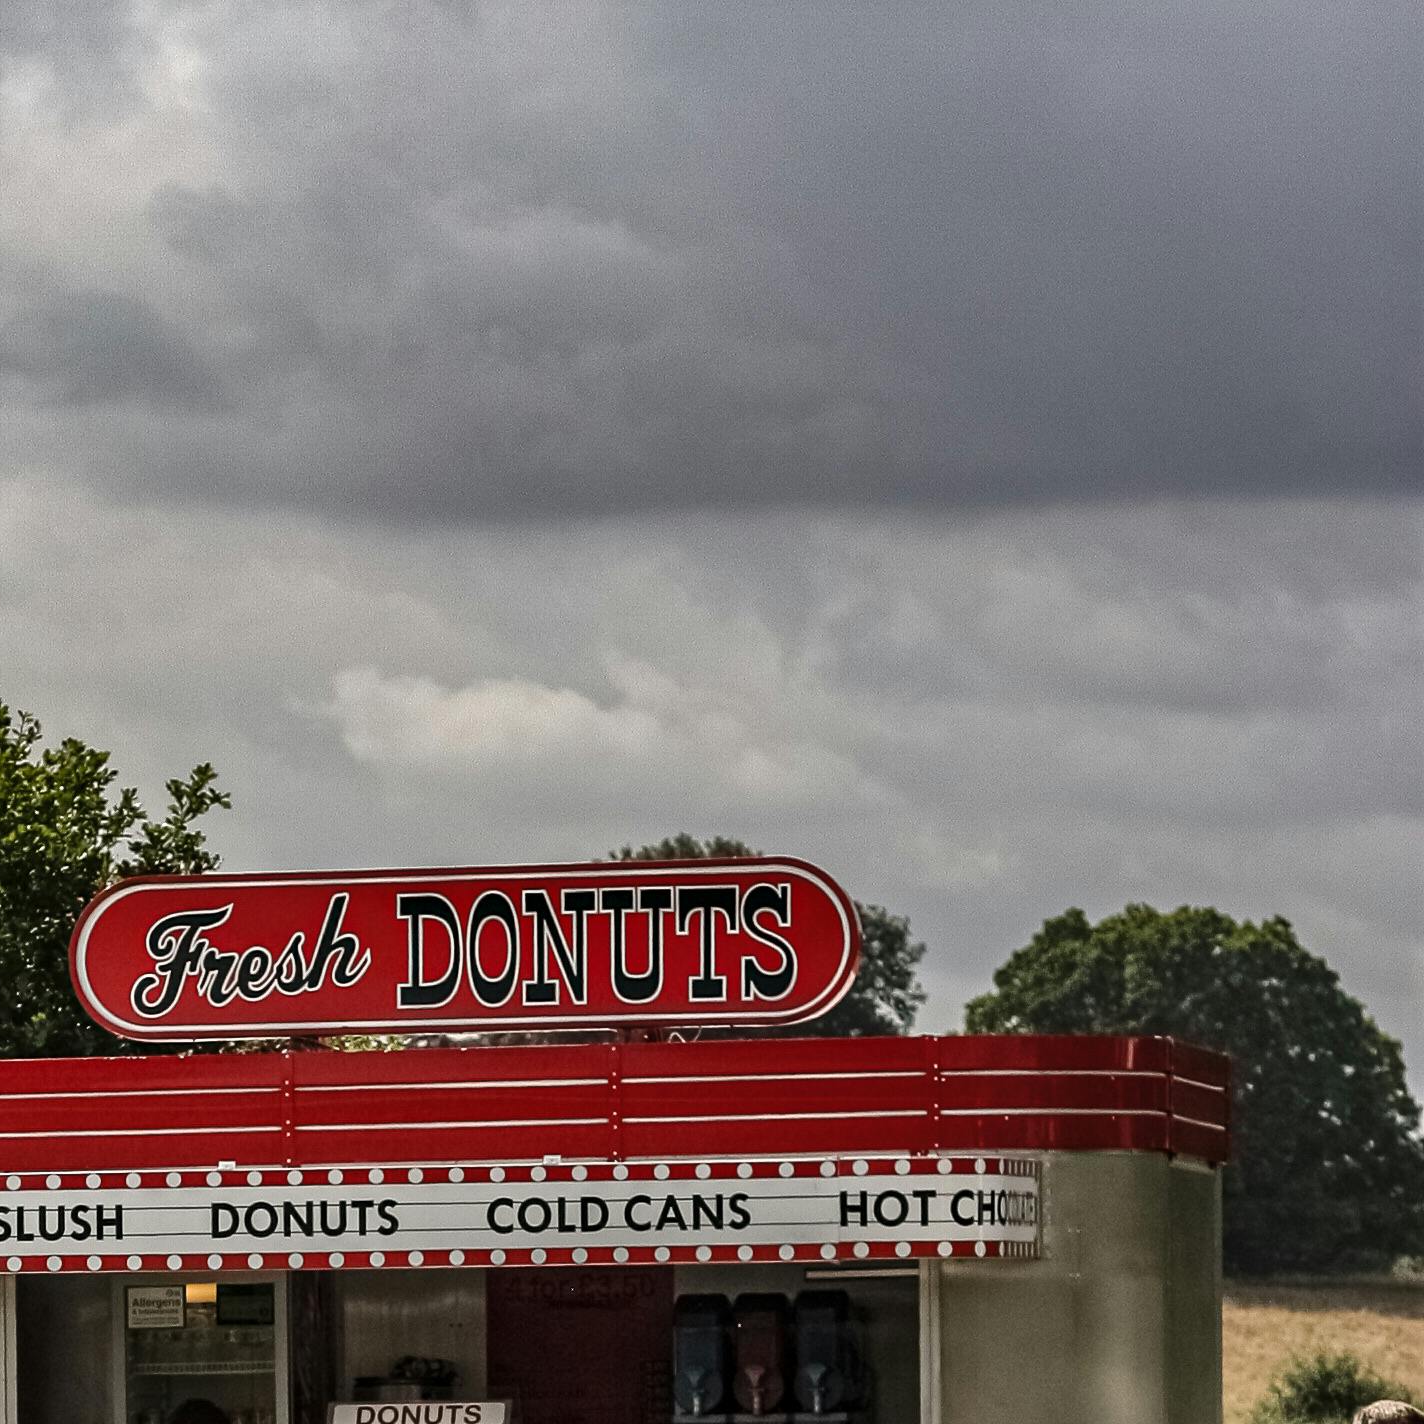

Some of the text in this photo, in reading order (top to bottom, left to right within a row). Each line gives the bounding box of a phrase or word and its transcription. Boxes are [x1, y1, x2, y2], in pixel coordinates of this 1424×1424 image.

[130, 883, 799, 1018] Fresh DONUTS
[210, 1199, 400, 1239] DONUTS
[487, 1194, 610, 1235] COLD
[624, 1193, 752, 1232] CANS
[839, 1189, 936, 1228] HOT
